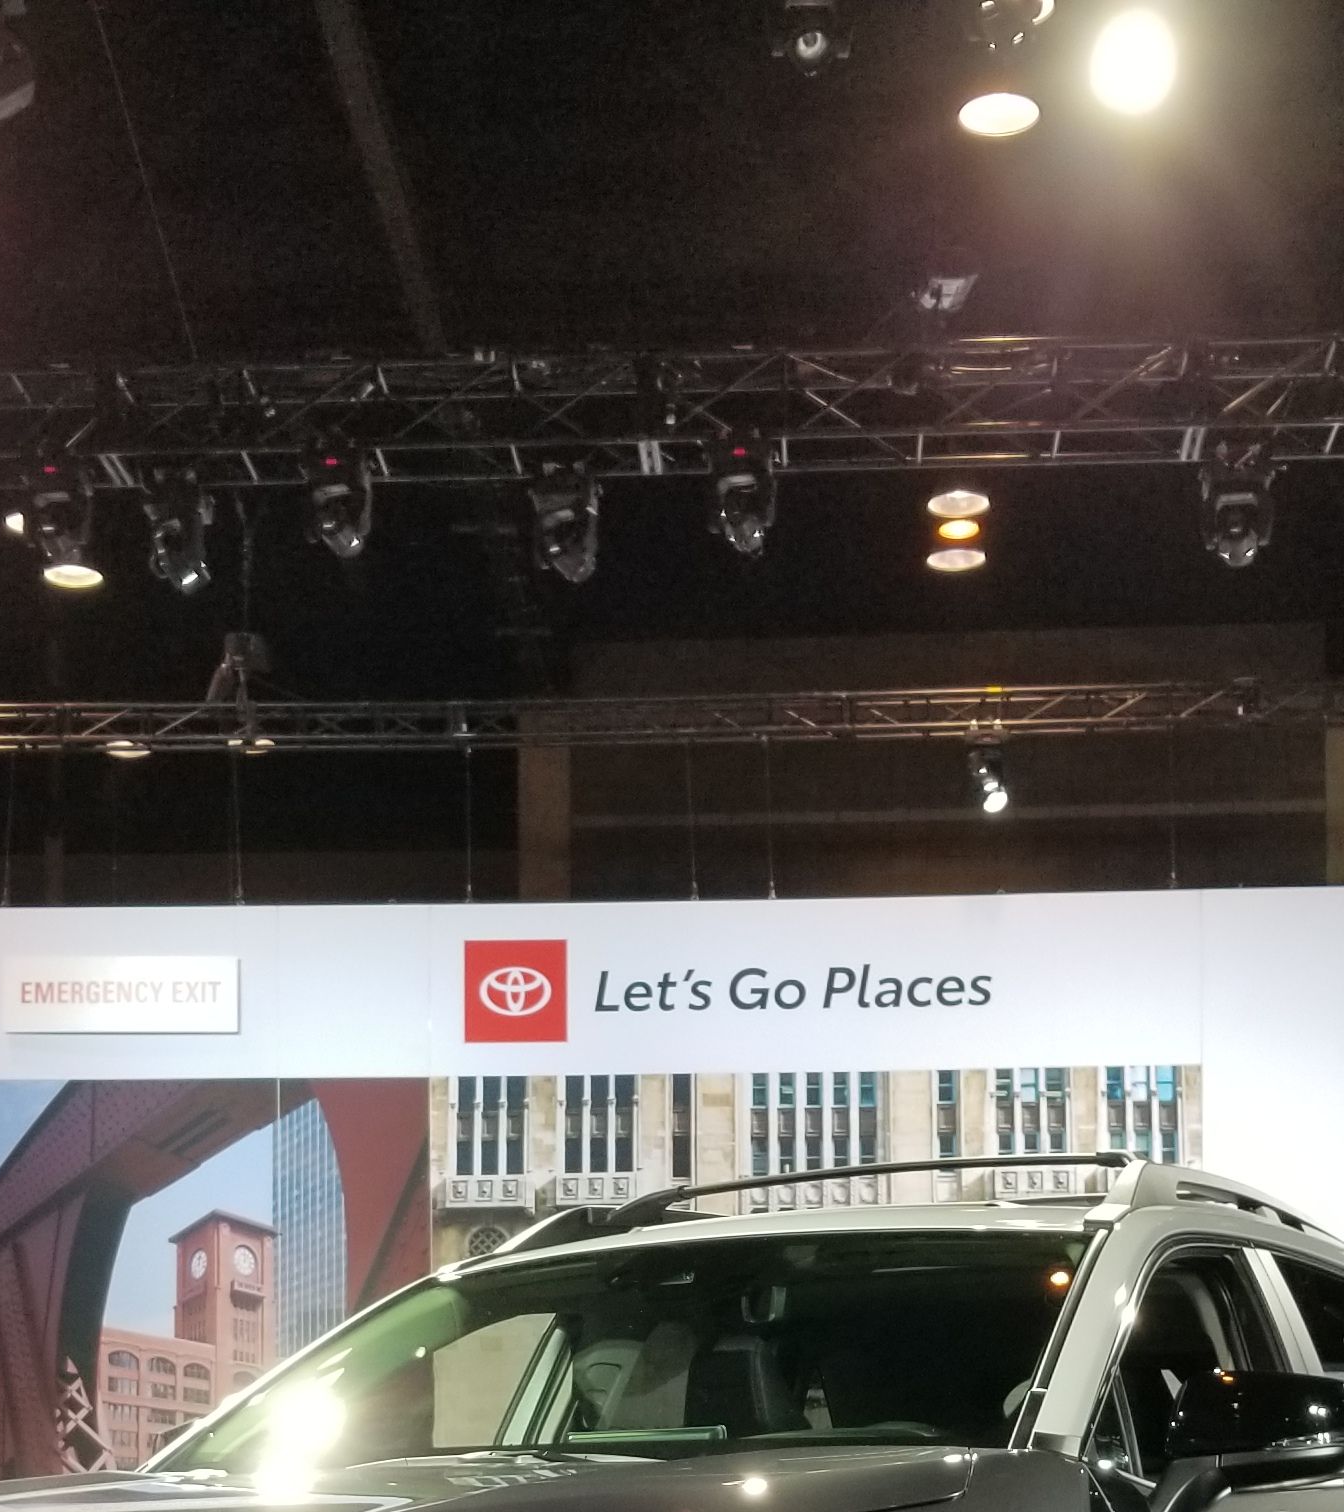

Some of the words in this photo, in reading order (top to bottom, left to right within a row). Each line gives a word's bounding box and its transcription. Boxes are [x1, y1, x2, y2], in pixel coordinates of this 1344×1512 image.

[20, 980, 164, 1004] EMERGENCY
[172, 980, 222, 1004] EXIT
[594, 969, 712, 1012] Let's
[729, 967, 806, 1010] Go
[823, 964, 993, 1009] Places
